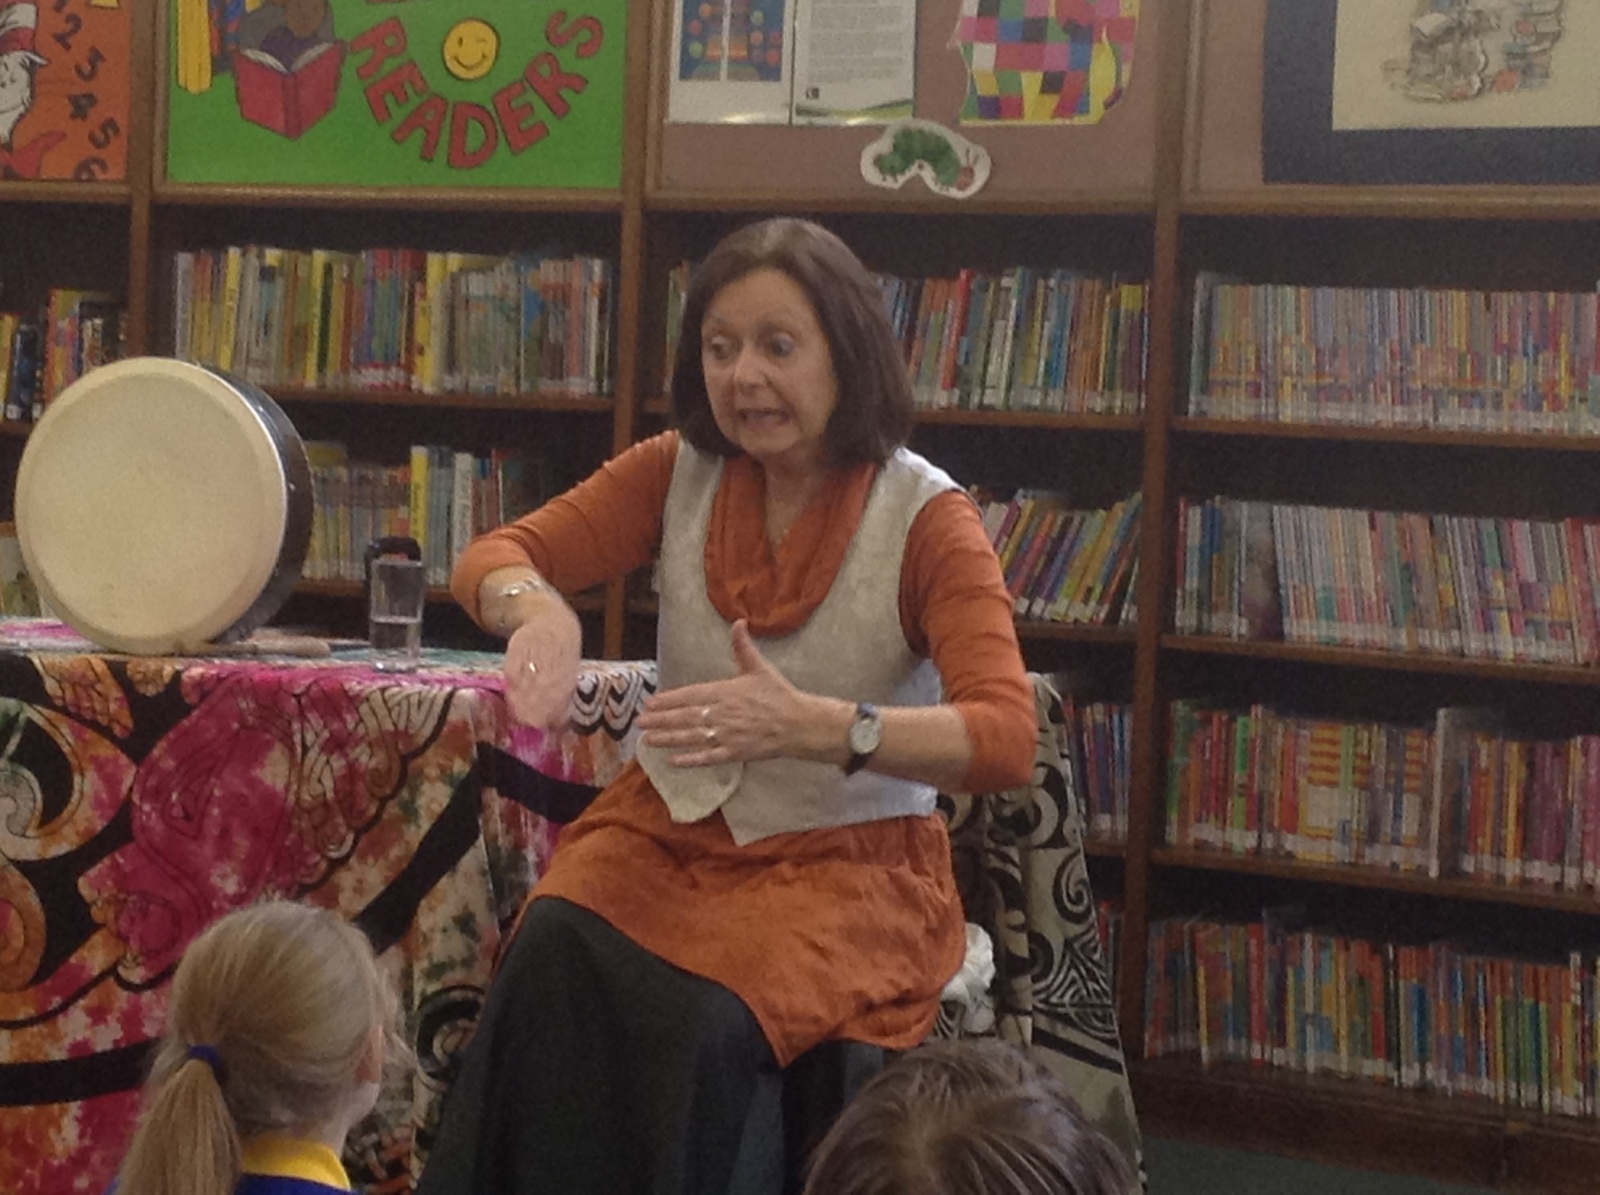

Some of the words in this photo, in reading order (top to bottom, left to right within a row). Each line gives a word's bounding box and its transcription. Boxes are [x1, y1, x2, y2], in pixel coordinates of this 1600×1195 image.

[53, 13, 82, 51] 2
[69, 93, 97, 121] 4
[350, 10, 604, 169] READERS
